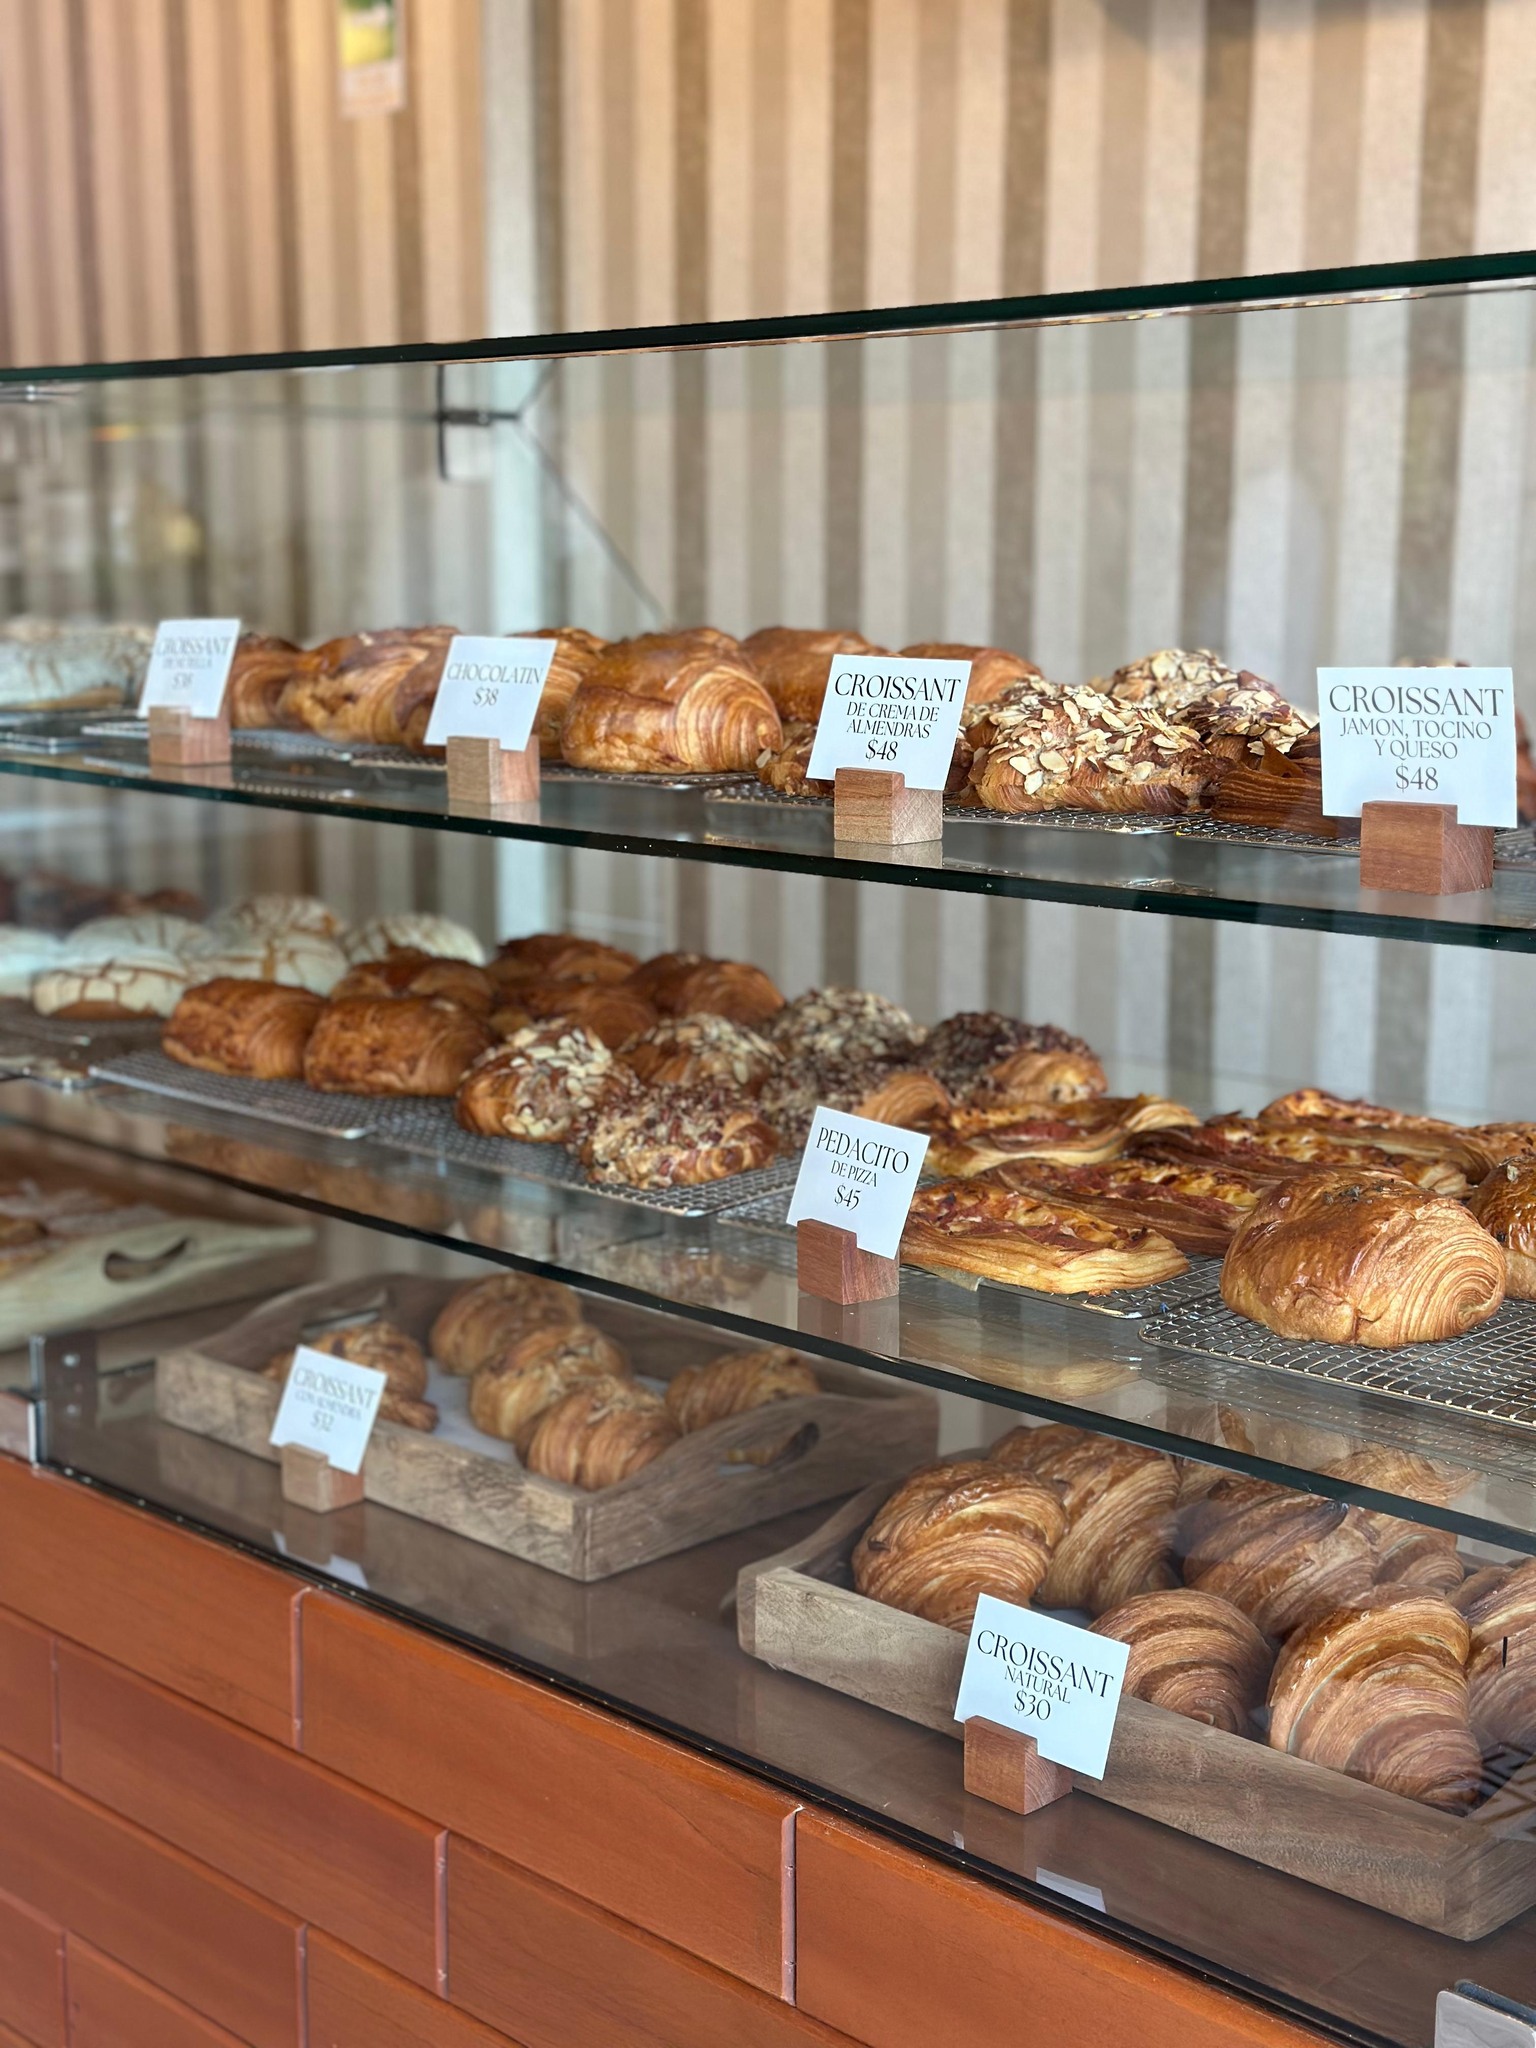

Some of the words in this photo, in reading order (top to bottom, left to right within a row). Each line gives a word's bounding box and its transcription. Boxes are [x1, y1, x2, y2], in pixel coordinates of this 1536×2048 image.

[446, 662, 544, 685] CHOCOLATIN
[834, 672, 961, 702] CROISSANT
[473, 686, 499, 707] $38
[1329, 684, 1504, 717] CROISSANT
[846, 701, 867, 717] DE
[868, 703, 917, 721] CREMA
[919, 706, 940, 722] DE
[846, 718, 932, 739] ALMENDRAS
[1340, 717, 1409, 739] JAMON,
[1412, 719, 1492, 740] TOCINO
[865, 737, 898, 762] $48
[1374, 739, 1386, 756] Y
[1389, 739, 1458, 761] QUESO
[1395, 762, 1439, 793] $48
[816, 1126, 910, 1174] PEDACITO
[830, 1159, 848, 1178] DE
[847, 1165, 878, 1188] PIZZA
[834, 1182, 861, 1211] $45
[293, 1367, 377, 1411] CROISSANT
[977, 1629, 1115, 1698] CROISSANT
[1004, 1665, 1071, 1705] NATURAL
[1014, 1688, 1051, 1721] $30
